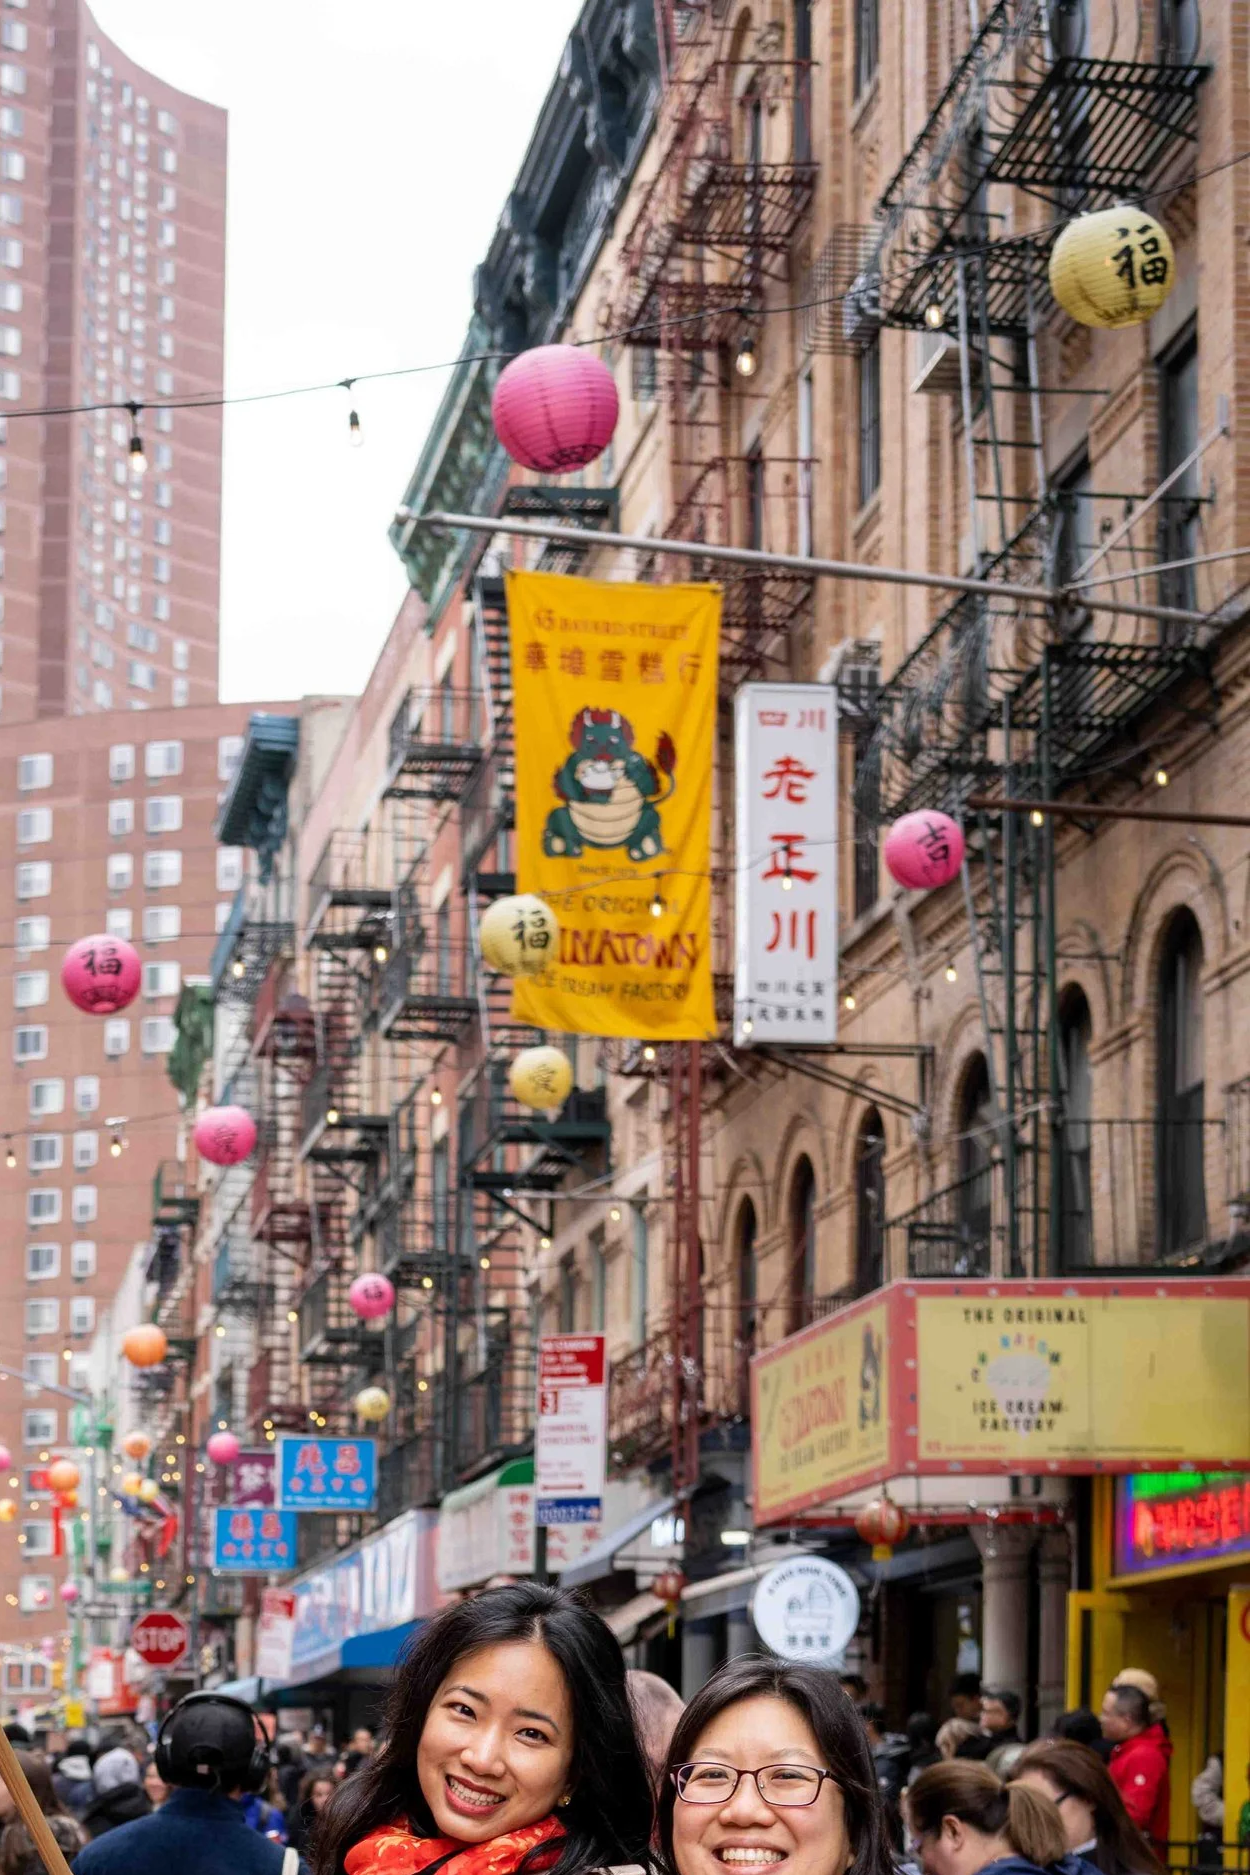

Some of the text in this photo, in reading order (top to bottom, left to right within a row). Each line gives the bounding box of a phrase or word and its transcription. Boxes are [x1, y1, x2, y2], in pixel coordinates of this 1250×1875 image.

[1111, 223, 1168, 289] 福
[758, 707, 827, 732] 四川
[511, 908, 551, 951] 福
[963, 1307, 1089, 1324] THE ORIGINAL
[972, 1401, 1064, 1414] ICE CREAM
[979, 1418, 1056, 1432] FACTORY
[133, 1626, 186, 1653] STOP
